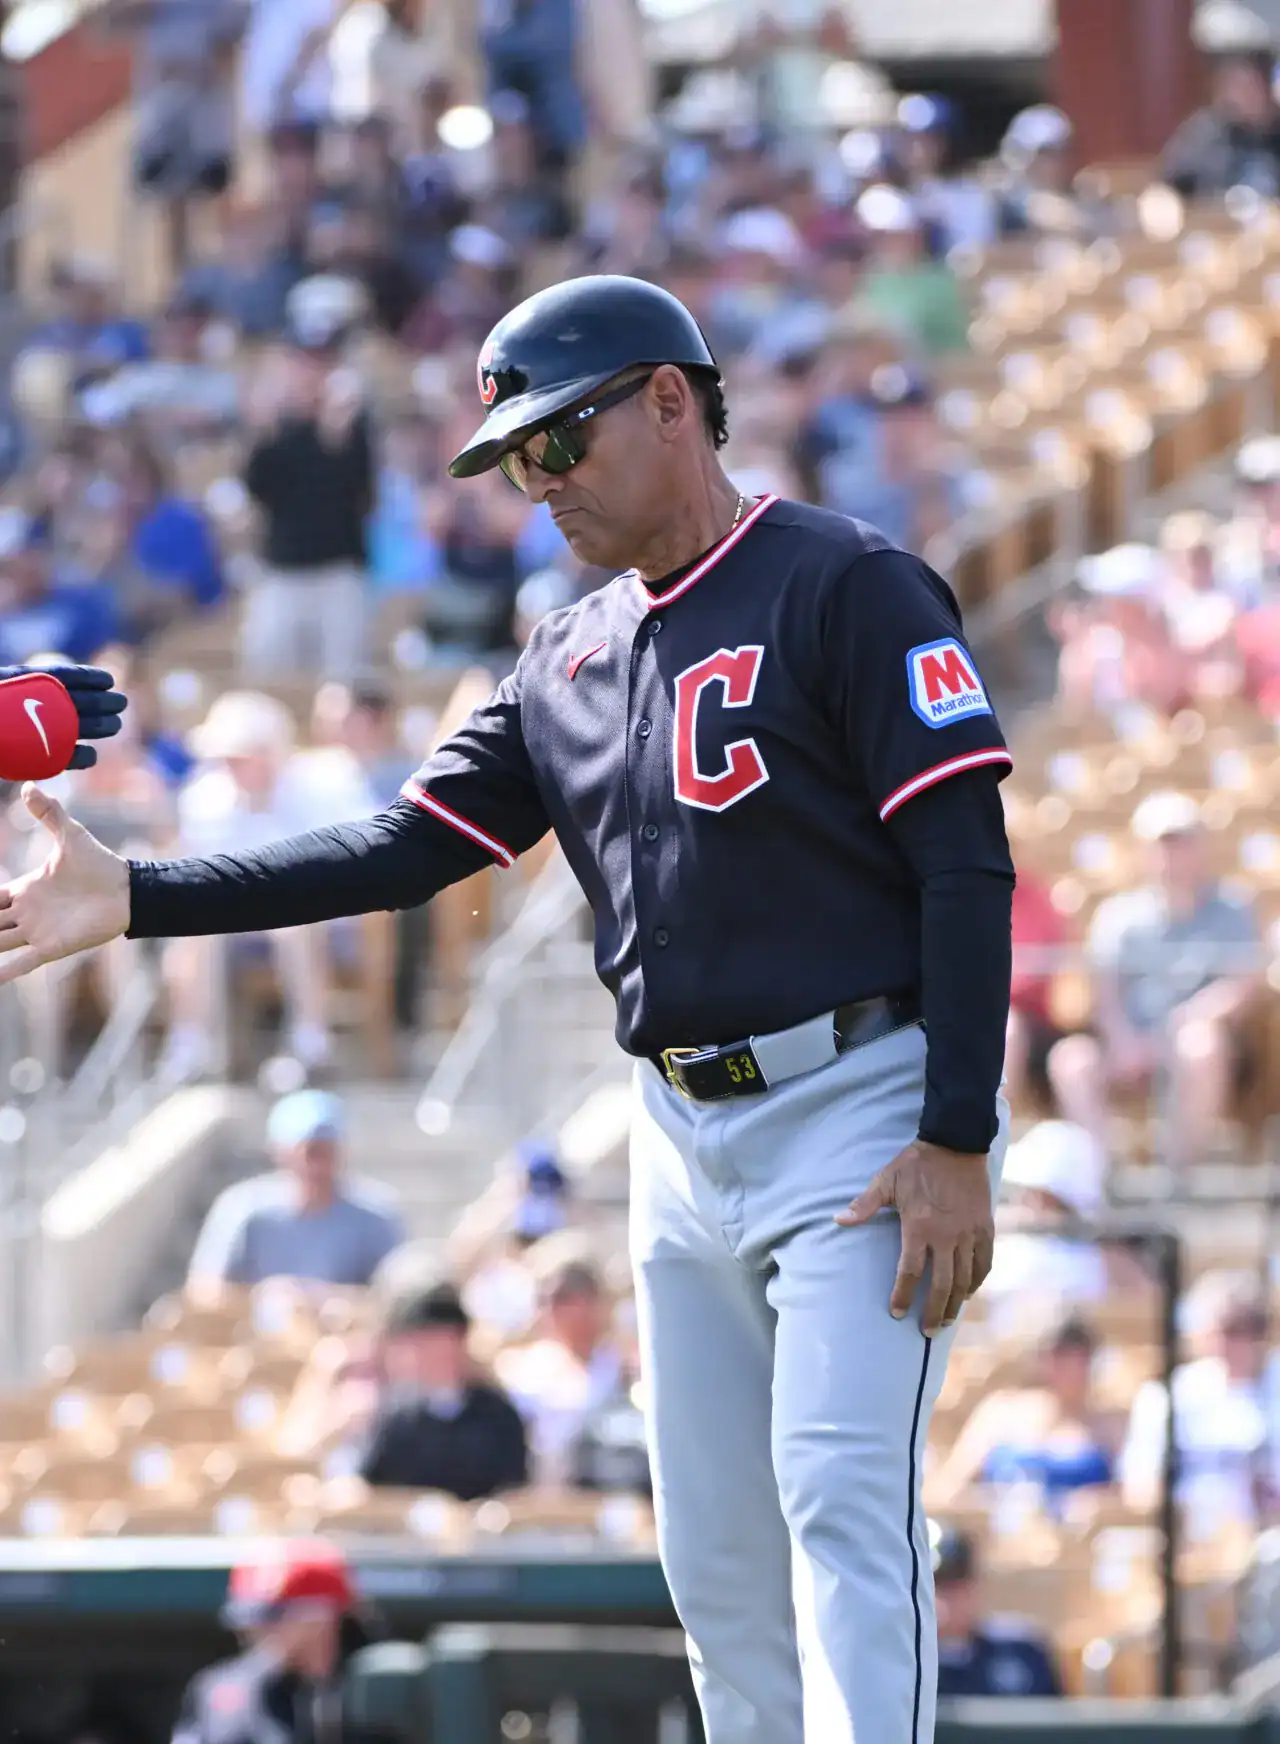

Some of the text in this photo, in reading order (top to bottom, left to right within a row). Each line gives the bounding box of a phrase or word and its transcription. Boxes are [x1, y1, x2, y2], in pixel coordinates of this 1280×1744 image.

[920, 648, 978, 703] M
[930, 692, 986, 717] Marathon
[673, 644, 770, 813] C
[725, 1054, 756, 1083] 53
